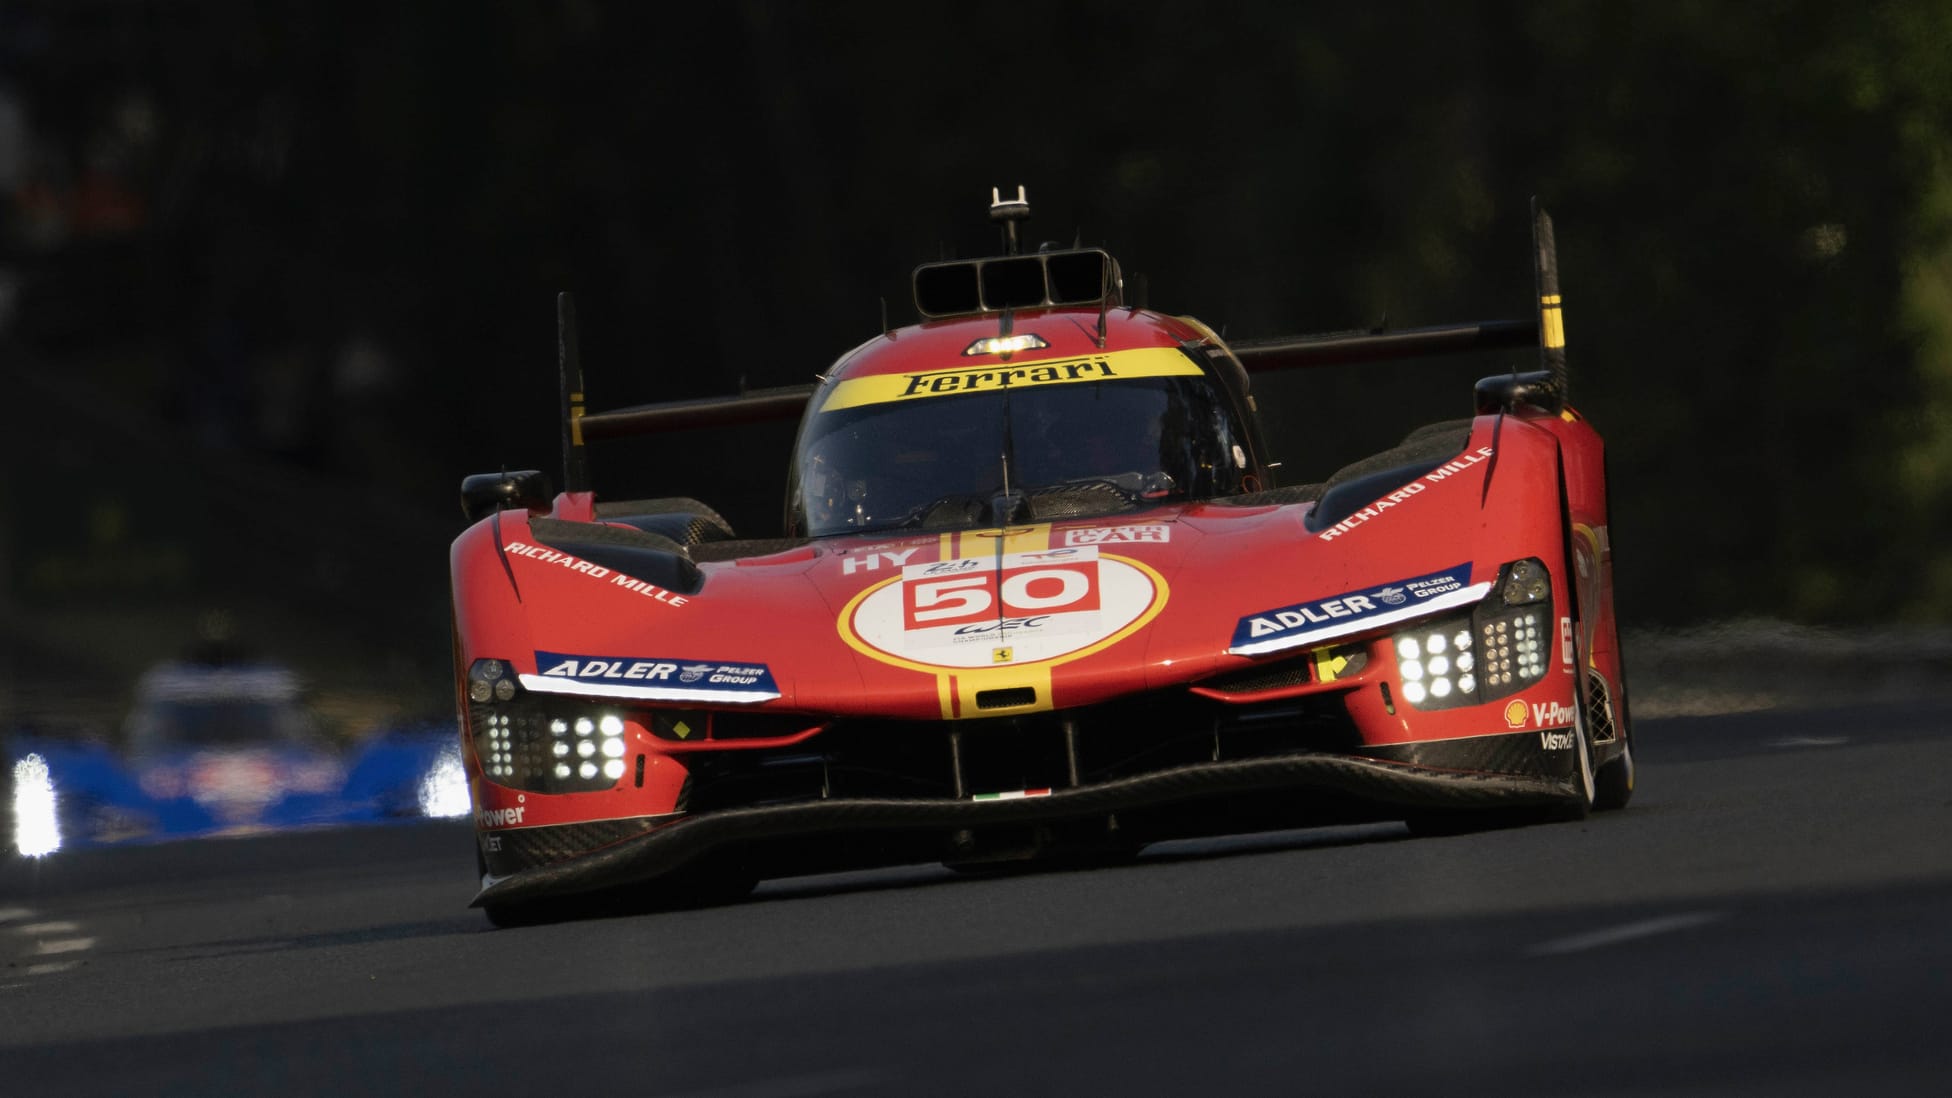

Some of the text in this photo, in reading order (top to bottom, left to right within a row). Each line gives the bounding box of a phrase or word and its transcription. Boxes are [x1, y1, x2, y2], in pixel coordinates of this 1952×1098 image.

[897, 356, 1117, 397] Ferrari
[1319, 446, 1494, 541] RICHARD MILLE
[1072, 531, 1162, 544] CAR
[504, 542, 689, 607] RICHARD MILLE
[843, 547, 920, 576] HY
[914, 569, 1089, 622] 50
[1248, 594, 1377, 638] ADLER
[543, 660, 678, 680] ADLER
